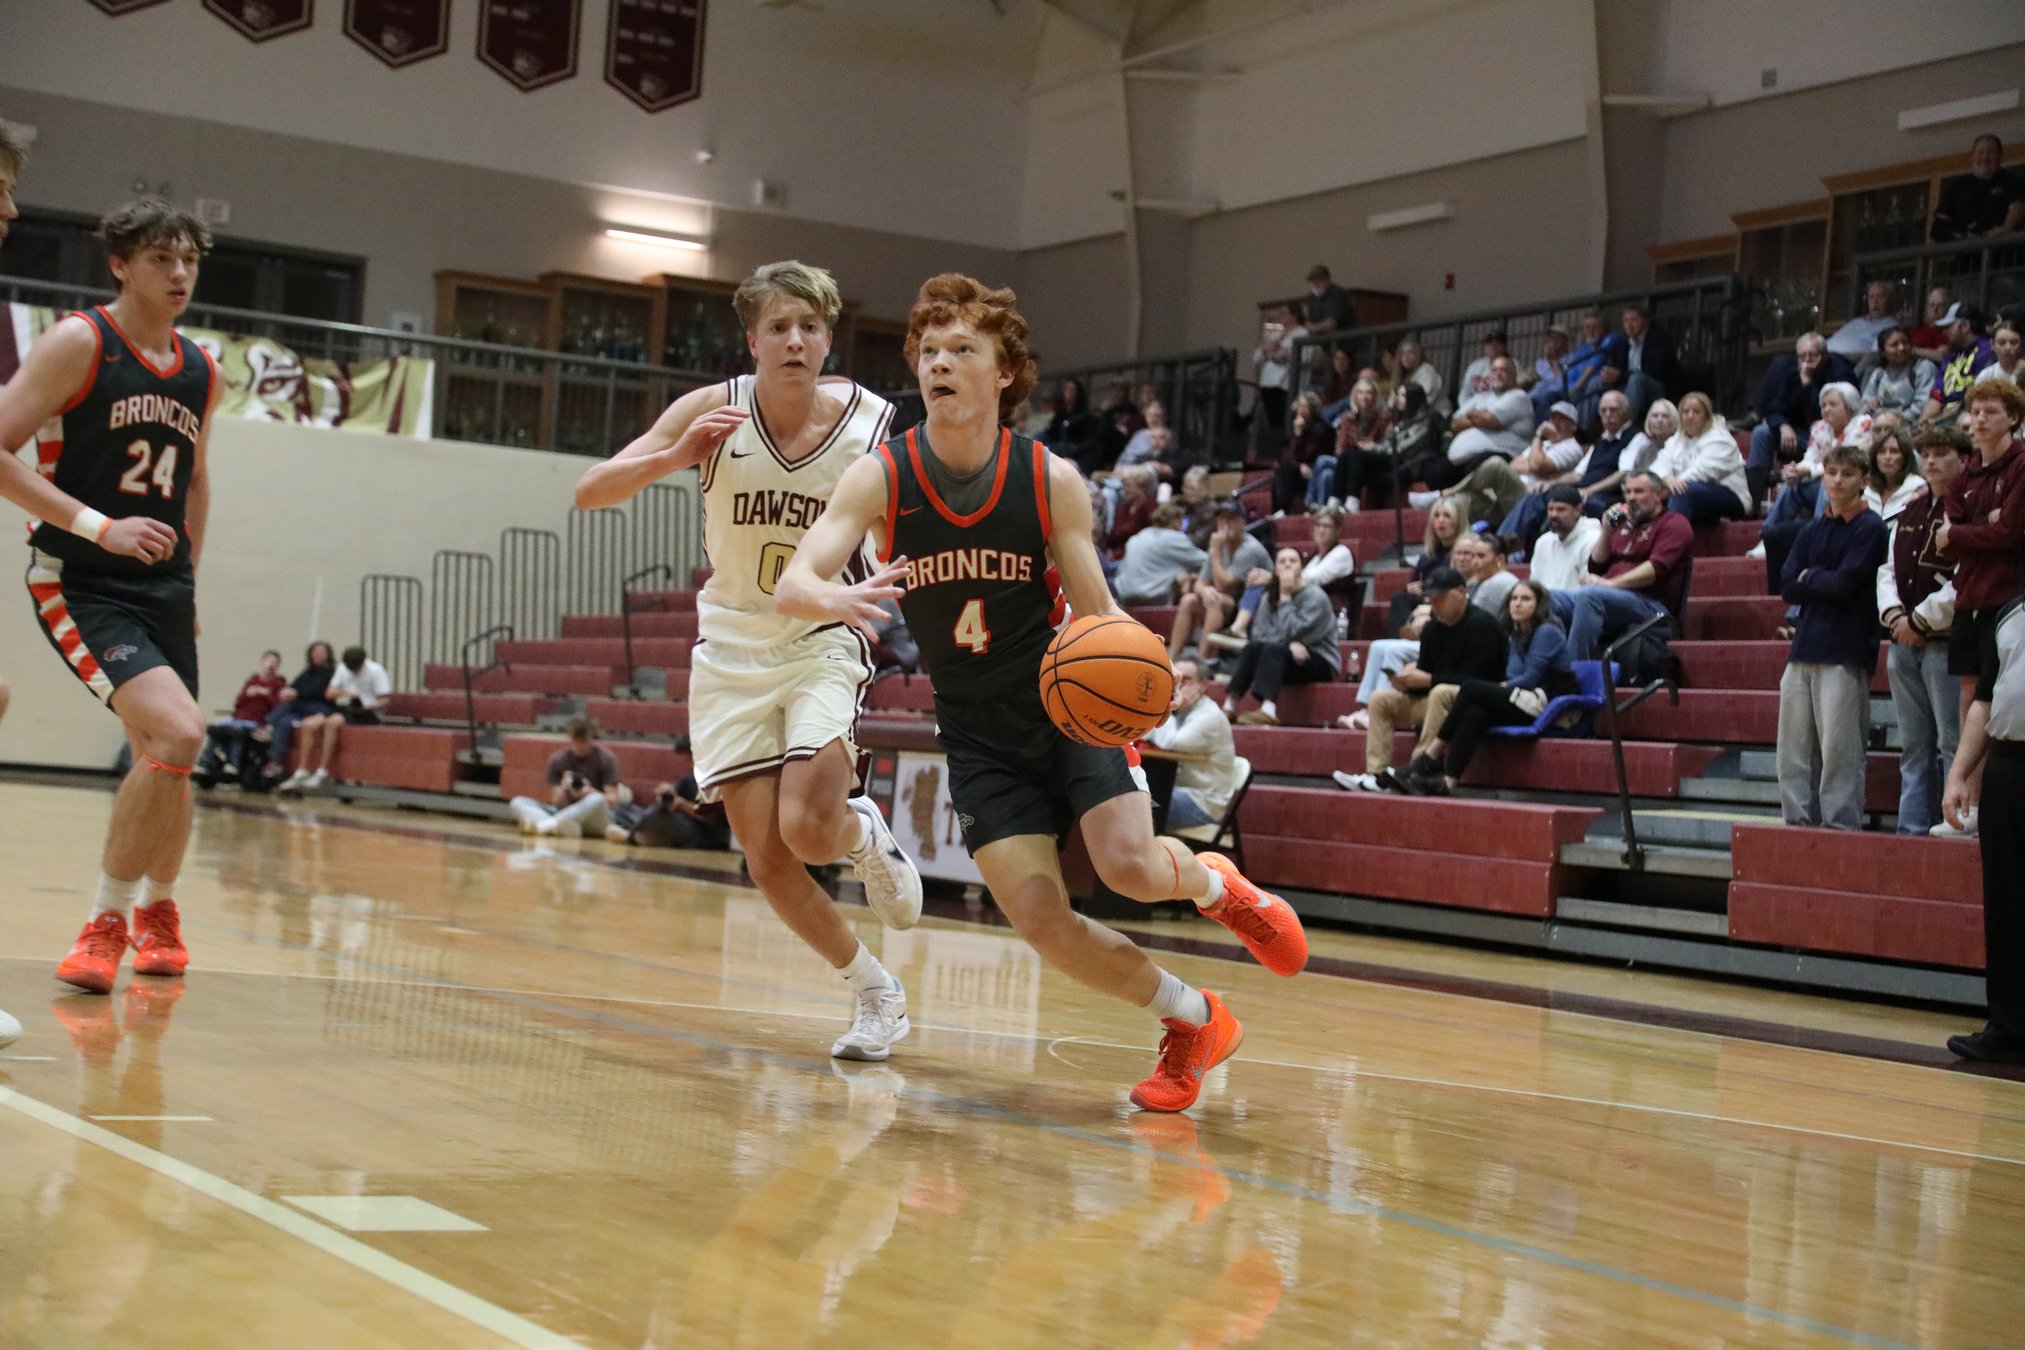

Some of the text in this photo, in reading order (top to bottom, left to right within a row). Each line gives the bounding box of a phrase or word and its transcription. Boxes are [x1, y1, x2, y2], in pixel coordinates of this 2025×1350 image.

[109, 394, 200, 444] BRONCOS
[118, 438, 178, 499] 24
[904, 548, 1033, 592] BRONCOS
[953, 598, 992, 654] 4
[1099, 720, 1147, 739] EVO
